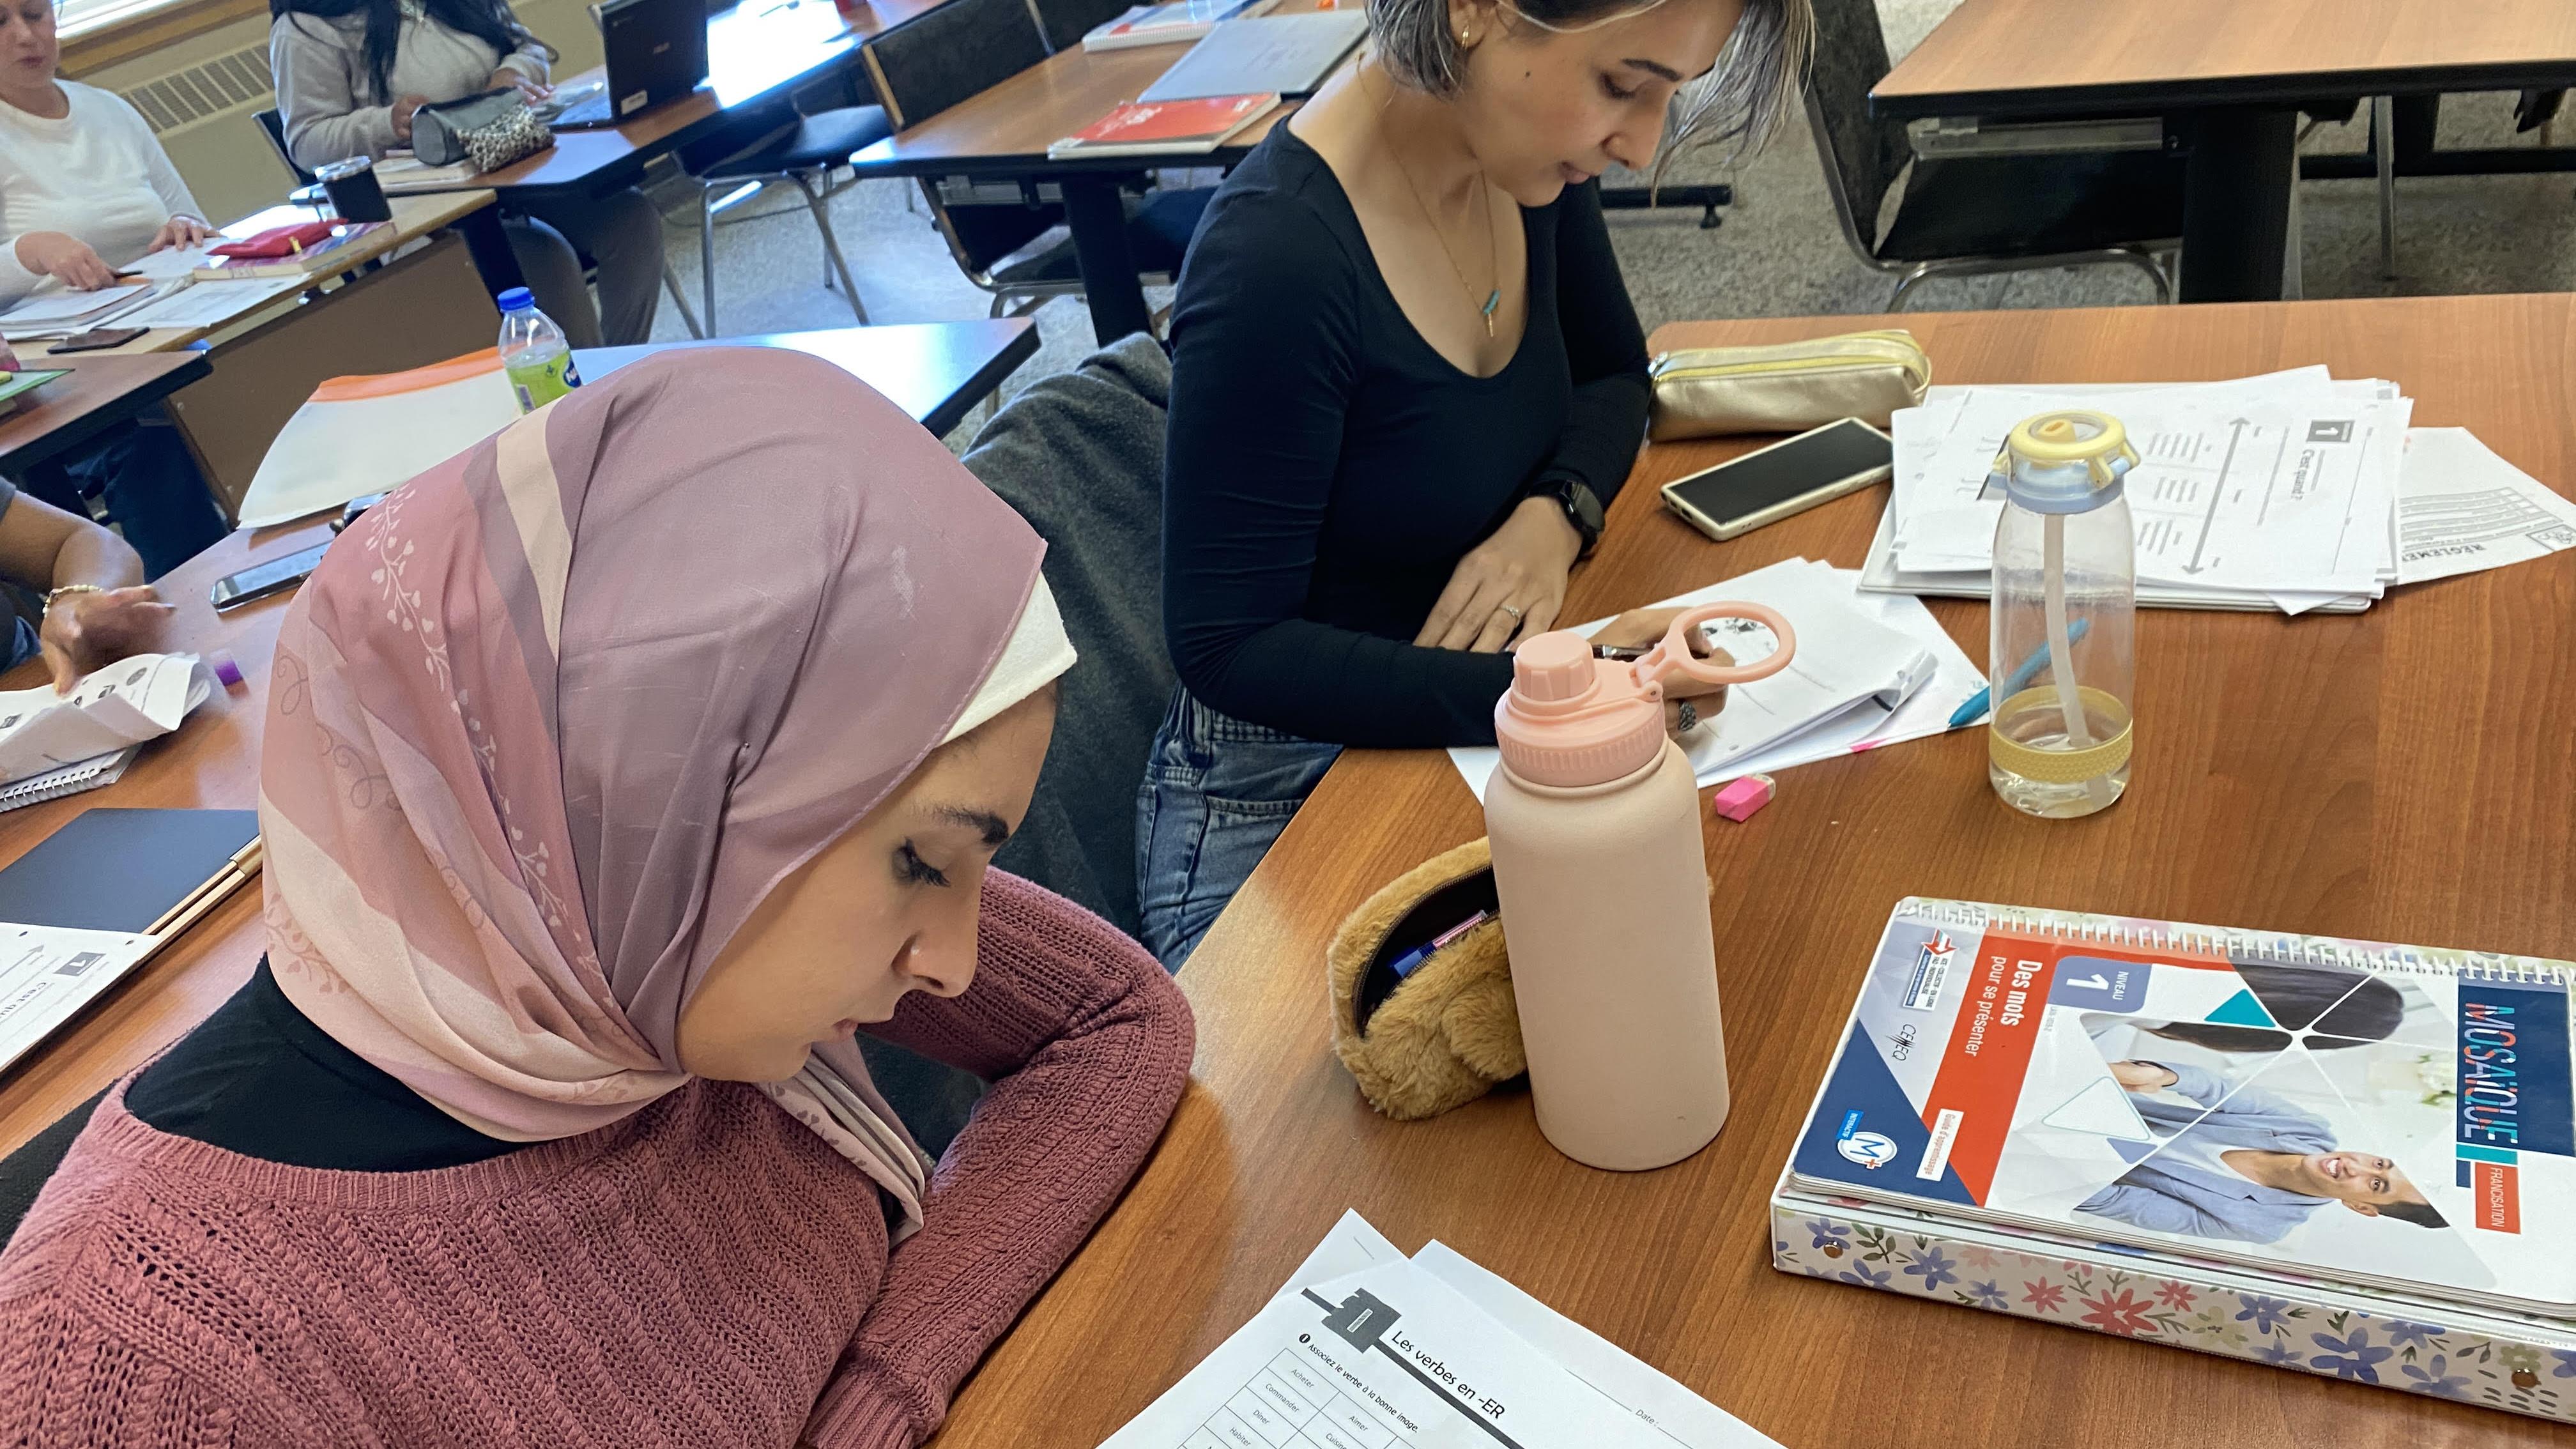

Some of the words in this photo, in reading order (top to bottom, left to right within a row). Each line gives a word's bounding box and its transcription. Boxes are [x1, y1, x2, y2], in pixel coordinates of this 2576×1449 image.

[2299, 448, 2315, 469] C'est
[1989, 956, 2007, 985] pour
[2011, 960, 2043, 989] Des
[2066, 973, 2110, 990] 1
[2112, 970, 2129, 1000] NIVEAU
[1982, 985, 1998, 999] se
[2000, 990, 2027, 1027] mots
[1965, 1000, 1994, 1057] présenter
[2489, 1167, 2505, 1228] FRANCISATION
[1291, 1368, 1314, 1388] Acheter
[1308, 1344, 1336, 1367] Associez
[1335, 1364, 1343, 1373] le
[1342, 1371, 1363, 1389] verbe
[1361, 1385, 1368, 1393] à
[1367, 1390, 1376, 1399] la
[1375, 1395, 1397, 1416] bonne
[1392, 1330, 1414, 1352] Les
[1415, 1350, 1457, 1384] verbes
[1457, 1383, 1476, 1399] en
[1478, 1398, 1505, 1420] -ER
[1265, 1383, 1300, 1413] Commander
[1229, 1427, 1252, 1446] Habiter
[1349, 1415, 1368, 1432] Aimer
[1325, 1432, 1347, 1449] Cuisine
